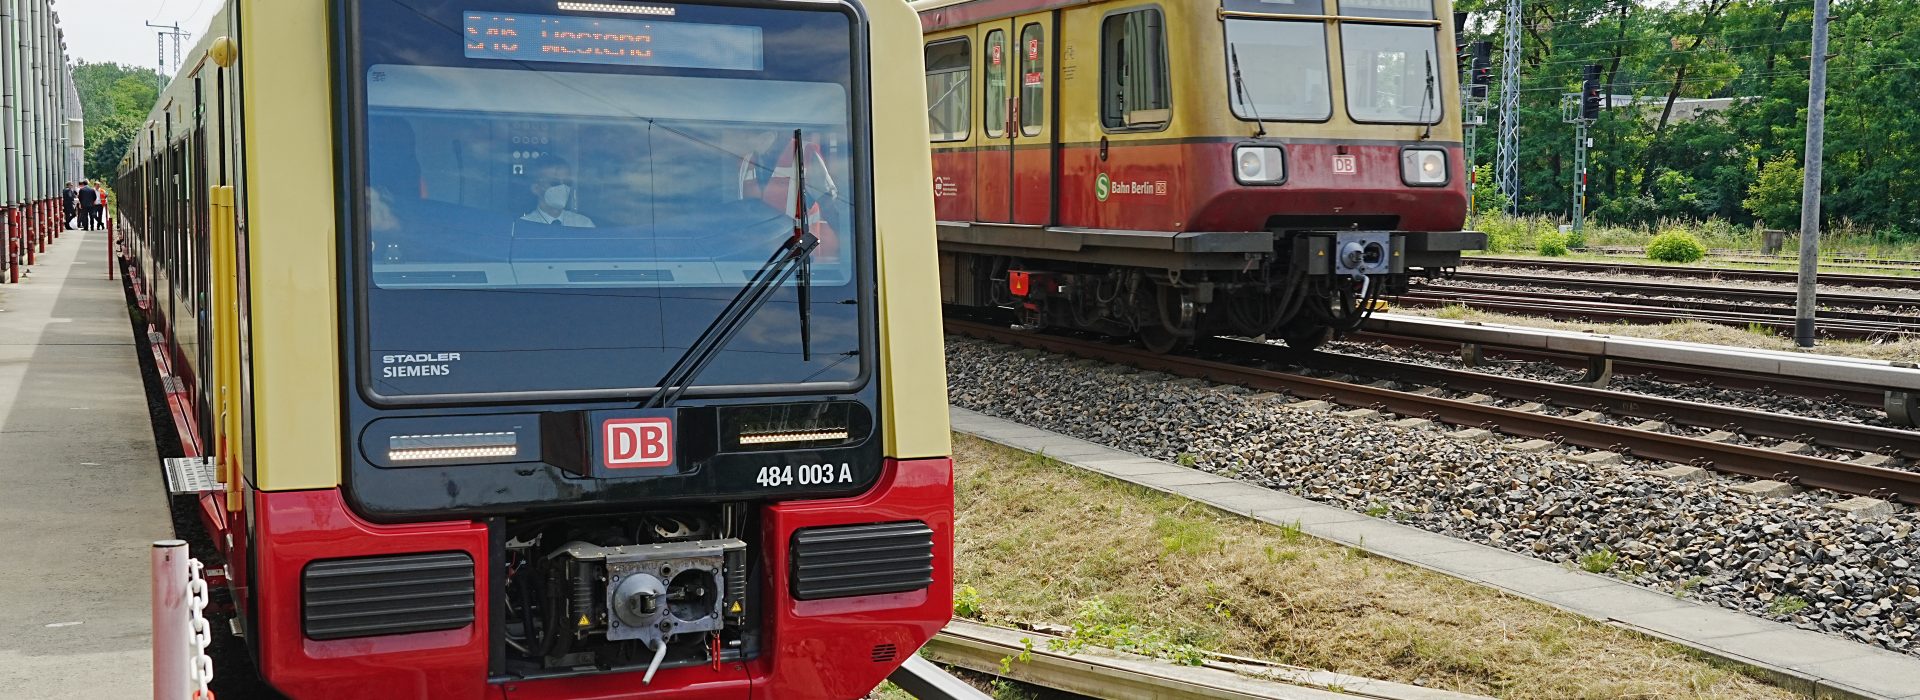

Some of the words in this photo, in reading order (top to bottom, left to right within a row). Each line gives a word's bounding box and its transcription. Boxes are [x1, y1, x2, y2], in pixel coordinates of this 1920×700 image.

[1335, 157, 1354, 172] DB
[1097, 175, 1109, 200] S
[1111, 181, 1130, 194] Bahn
[1131, 181, 1154, 194] Berlin
[382, 352, 461, 364] STADLER
[383, 364, 450, 378] SIEMENS
[611, 424, 666, 462] DB
[756, 465, 793, 487] 484
[798, 463, 834, 485] 003
[838, 462, 853, 483] A
